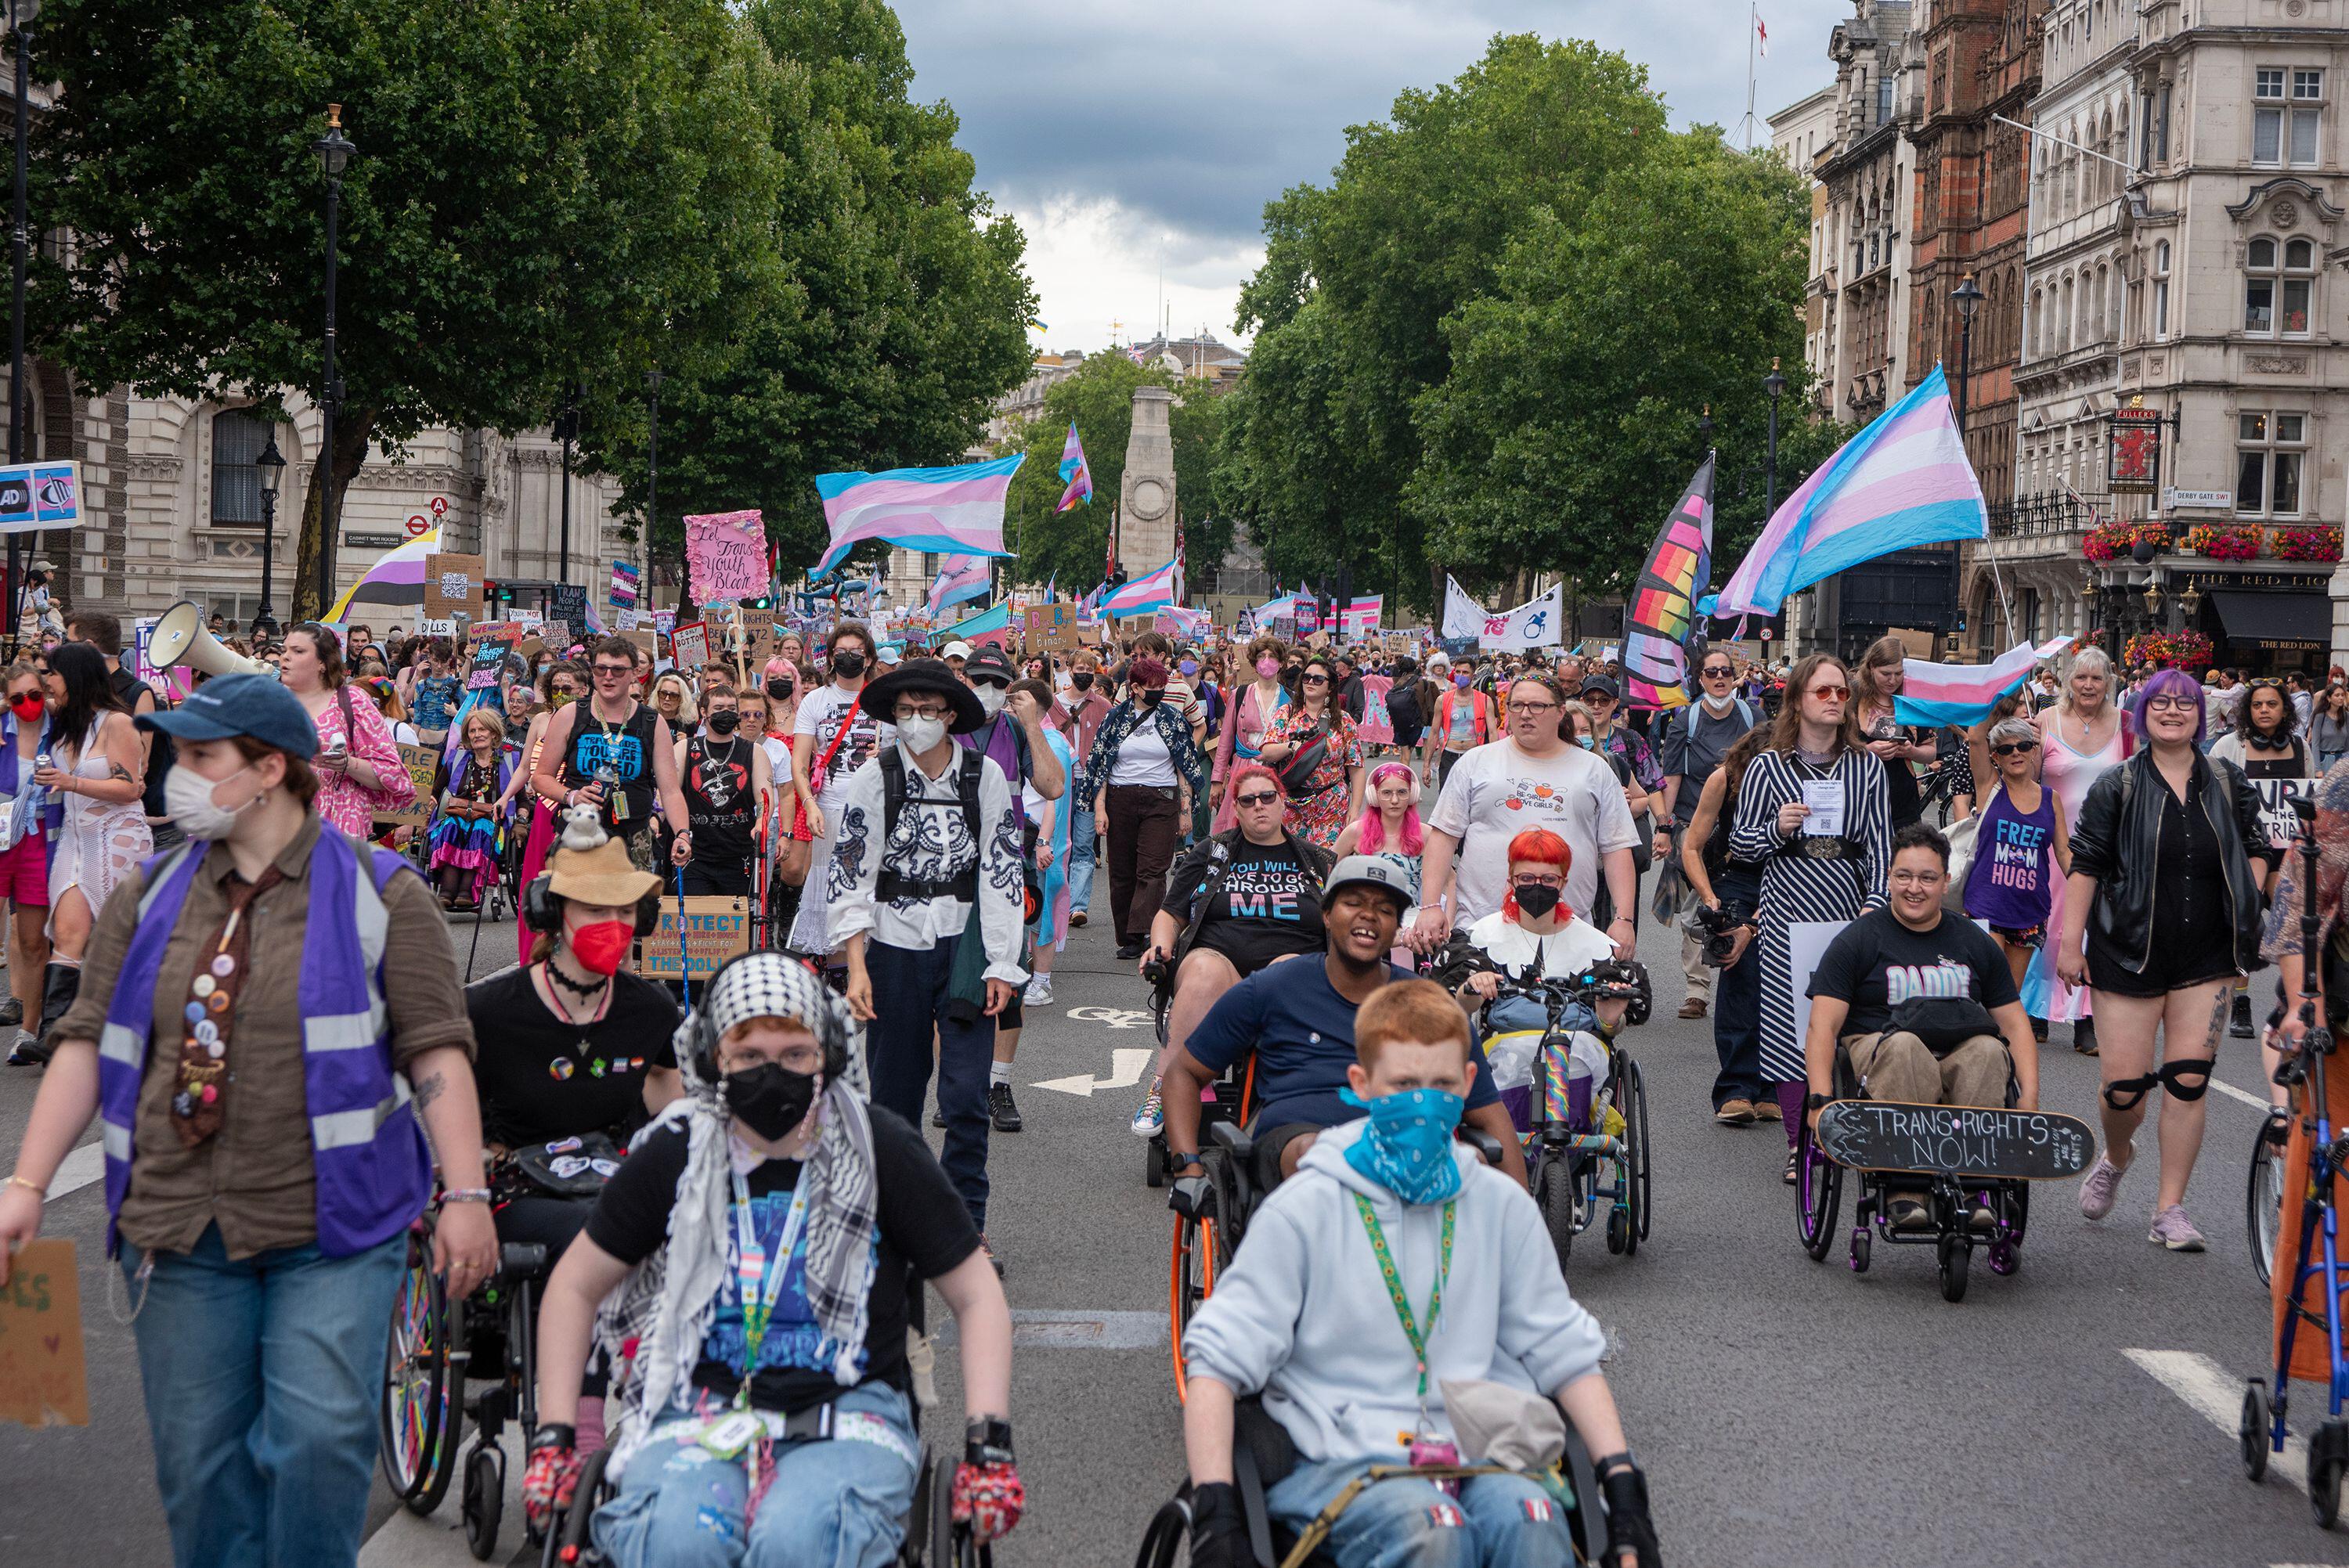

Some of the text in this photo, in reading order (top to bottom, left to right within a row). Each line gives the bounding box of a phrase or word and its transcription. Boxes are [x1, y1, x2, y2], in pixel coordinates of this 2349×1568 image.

[433, 498, 446, 511] A
[699, 525, 719, 541] Let
[717, 541, 753, 557] Trans
[702, 556, 749, 582] Youth
[2186, 574, 2327, 586] THE RED LIO
[555, 586, 586, 600] TRANS
[558, 597, 580, 606] PEOPLE
[552, 611, 585, 620] LEGISLATED
[421, 622, 448, 633] DLLS
[546, 629, 568, 637] SESSED
[677, 633, 705, 647] BOTTOM
[476, 653, 500, 661] STREET
[478, 647, 506, 655] DOWNING
[467, 680, 499, 689] BATHROOM
[584, 744, 609, 758] YOU
[691, 741, 700, 750] A
[690, 812, 749, 828] NO FEAR
[1997, 819, 2045, 848] FREE
[2263, 822, 2297, 842] TRIA
[1229, 860, 1299, 874] YOU WILL
[1226, 872, 1257, 881] AVE
[1261, 873, 1281, 883] TO
[1992, 863, 2037, 891] HUGS
[1230, 893, 1301, 921] ME
[662, 914, 744, 931] ROTECT
[648, 957, 722, 971] THE DOLL
[1886, 965, 1971, 1005] DADDY
[1864, 1107, 2049, 1144] TRANS RIGHTS
[1912, 1137, 1997, 1169] NOW!
